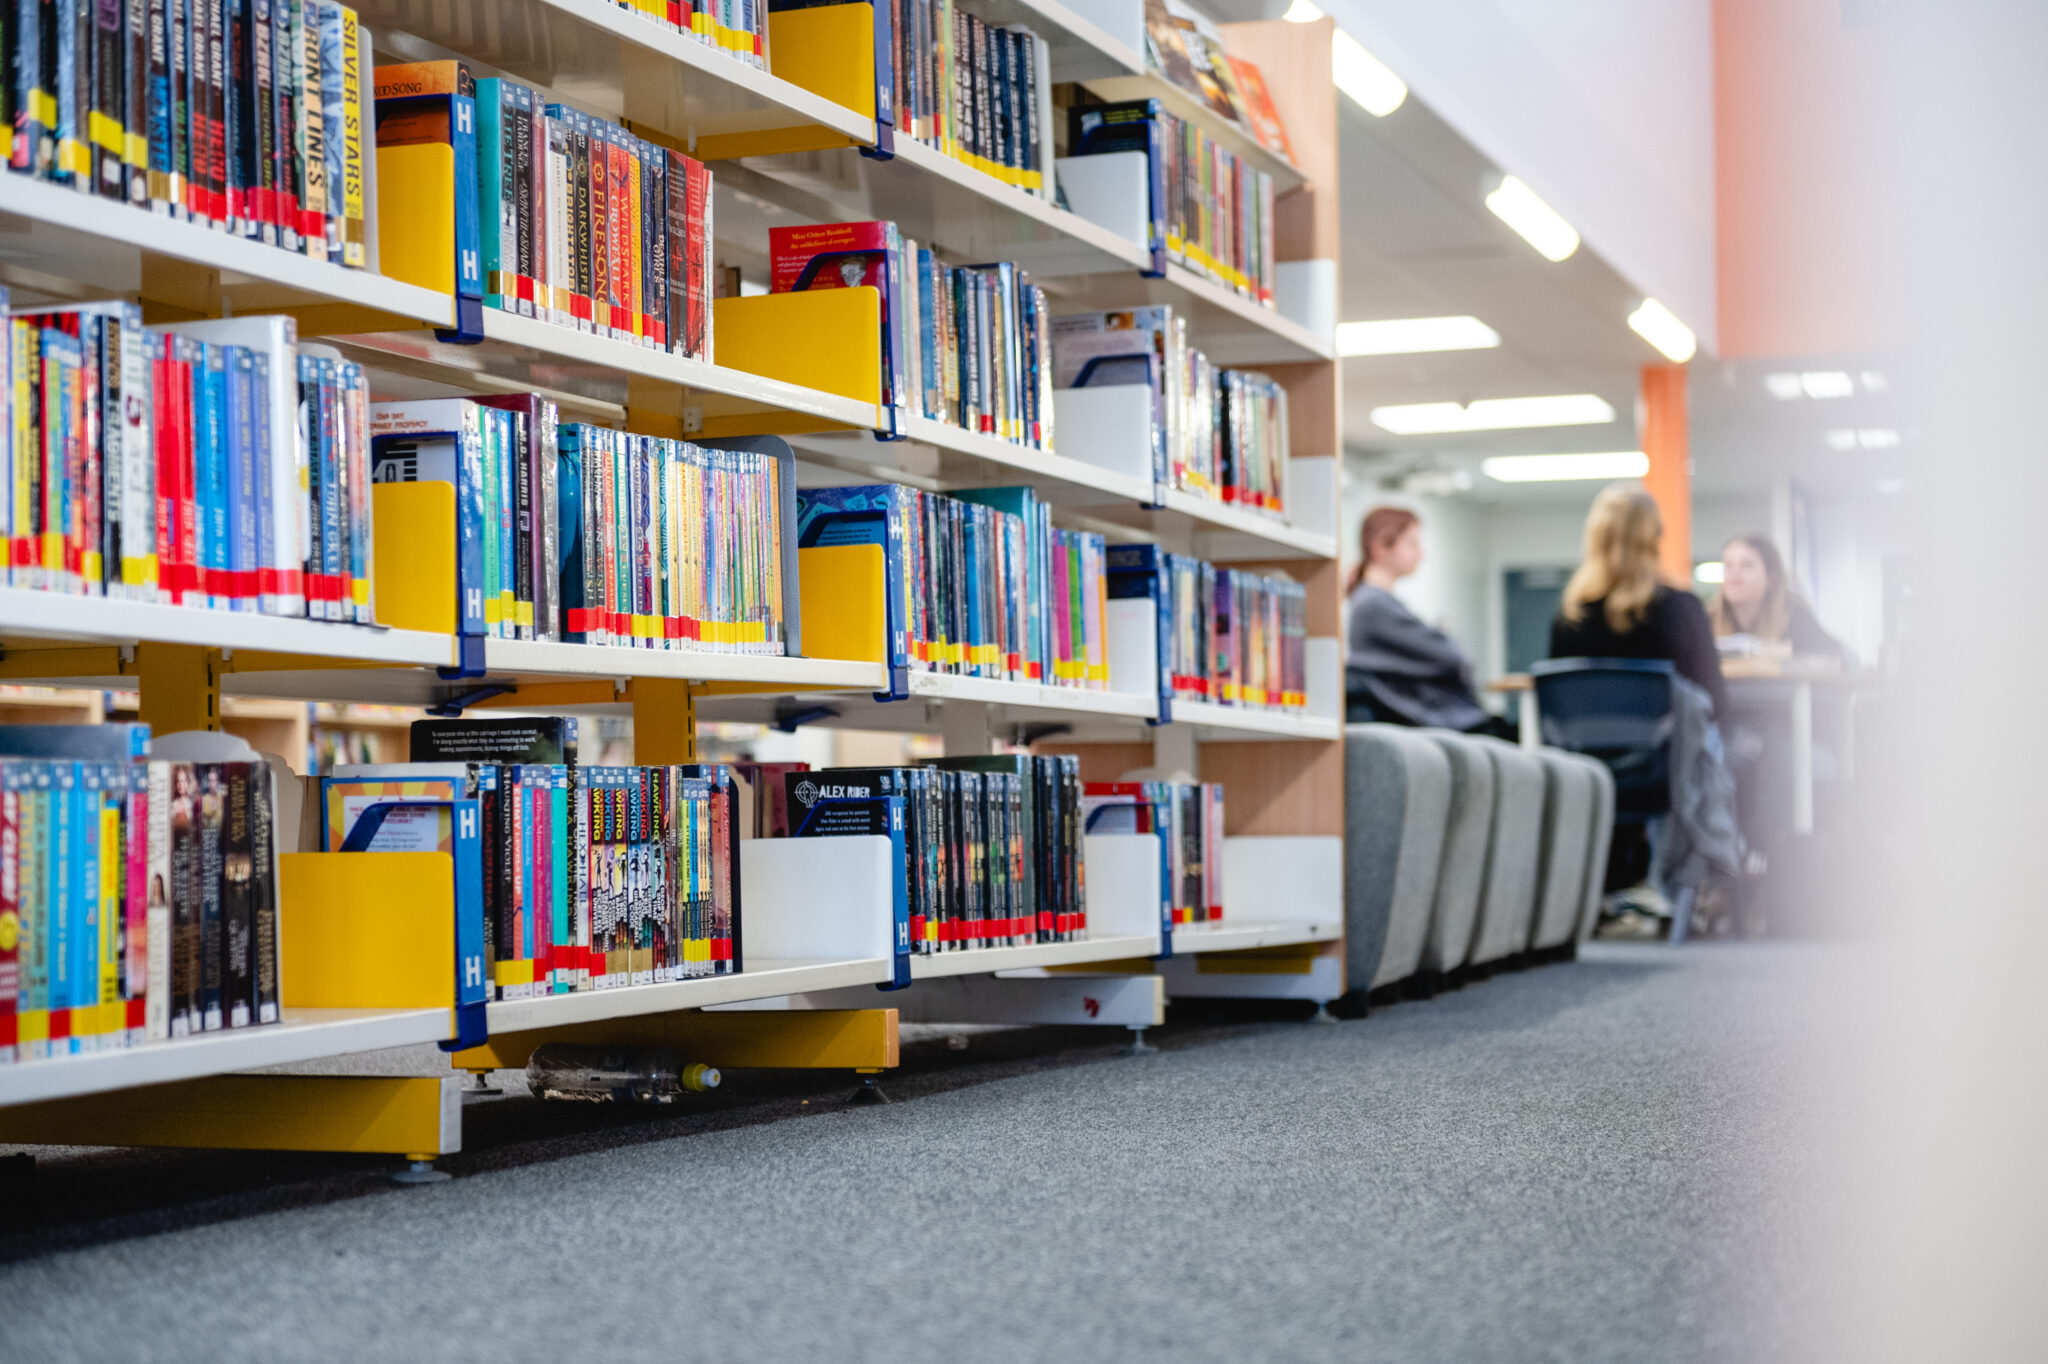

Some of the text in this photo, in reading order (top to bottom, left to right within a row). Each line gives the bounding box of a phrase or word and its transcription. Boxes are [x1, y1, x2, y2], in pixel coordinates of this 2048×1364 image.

[194, 32, 205, 82] GRANT
[210, 40, 223, 89] GRANT
[304, 28, 325, 188] RONT LINES
[343, 18, 362, 198] SILVER STARS
[457, 102, 472, 134] H
[994, 84, 1005, 166] FALLE
[210, 120, 225, 182] HERO
[502, 113, 515, 203] LIE TREE
[463, 249, 477, 281] H
[577, 187, 591, 298] DARKWHISPE
[610, 194, 622, 283] CROWFALL
[620, 196, 630, 302] WILDSPARK
[652, 244, 660, 284] GIRLS
[657, 234, 666, 298] DEATHLESS
[518, 462, 529, 506] HARRIS
[311, 542, 320, 574] GREE
[327, 482, 338, 575] JOHN GREE
[467, 588, 481, 618] H
[895, 631, 906, 655] H
[652, 772, 660, 840] HAWKING
[819, 785, 845, 798] ALEX
[893, 807, 902, 831] H
[460, 808, 476, 839] H
[485, 794, 496, 909] SERAPHINA
[503, 771, 512, 883] HAUNTING VIOLET
[513, 787, 522, 895] EMMY LEVELS UP
[578, 822, 588, 907] HEX HALL
[899, 922, 908, 945] H
[465, 955, 481, 987] H
